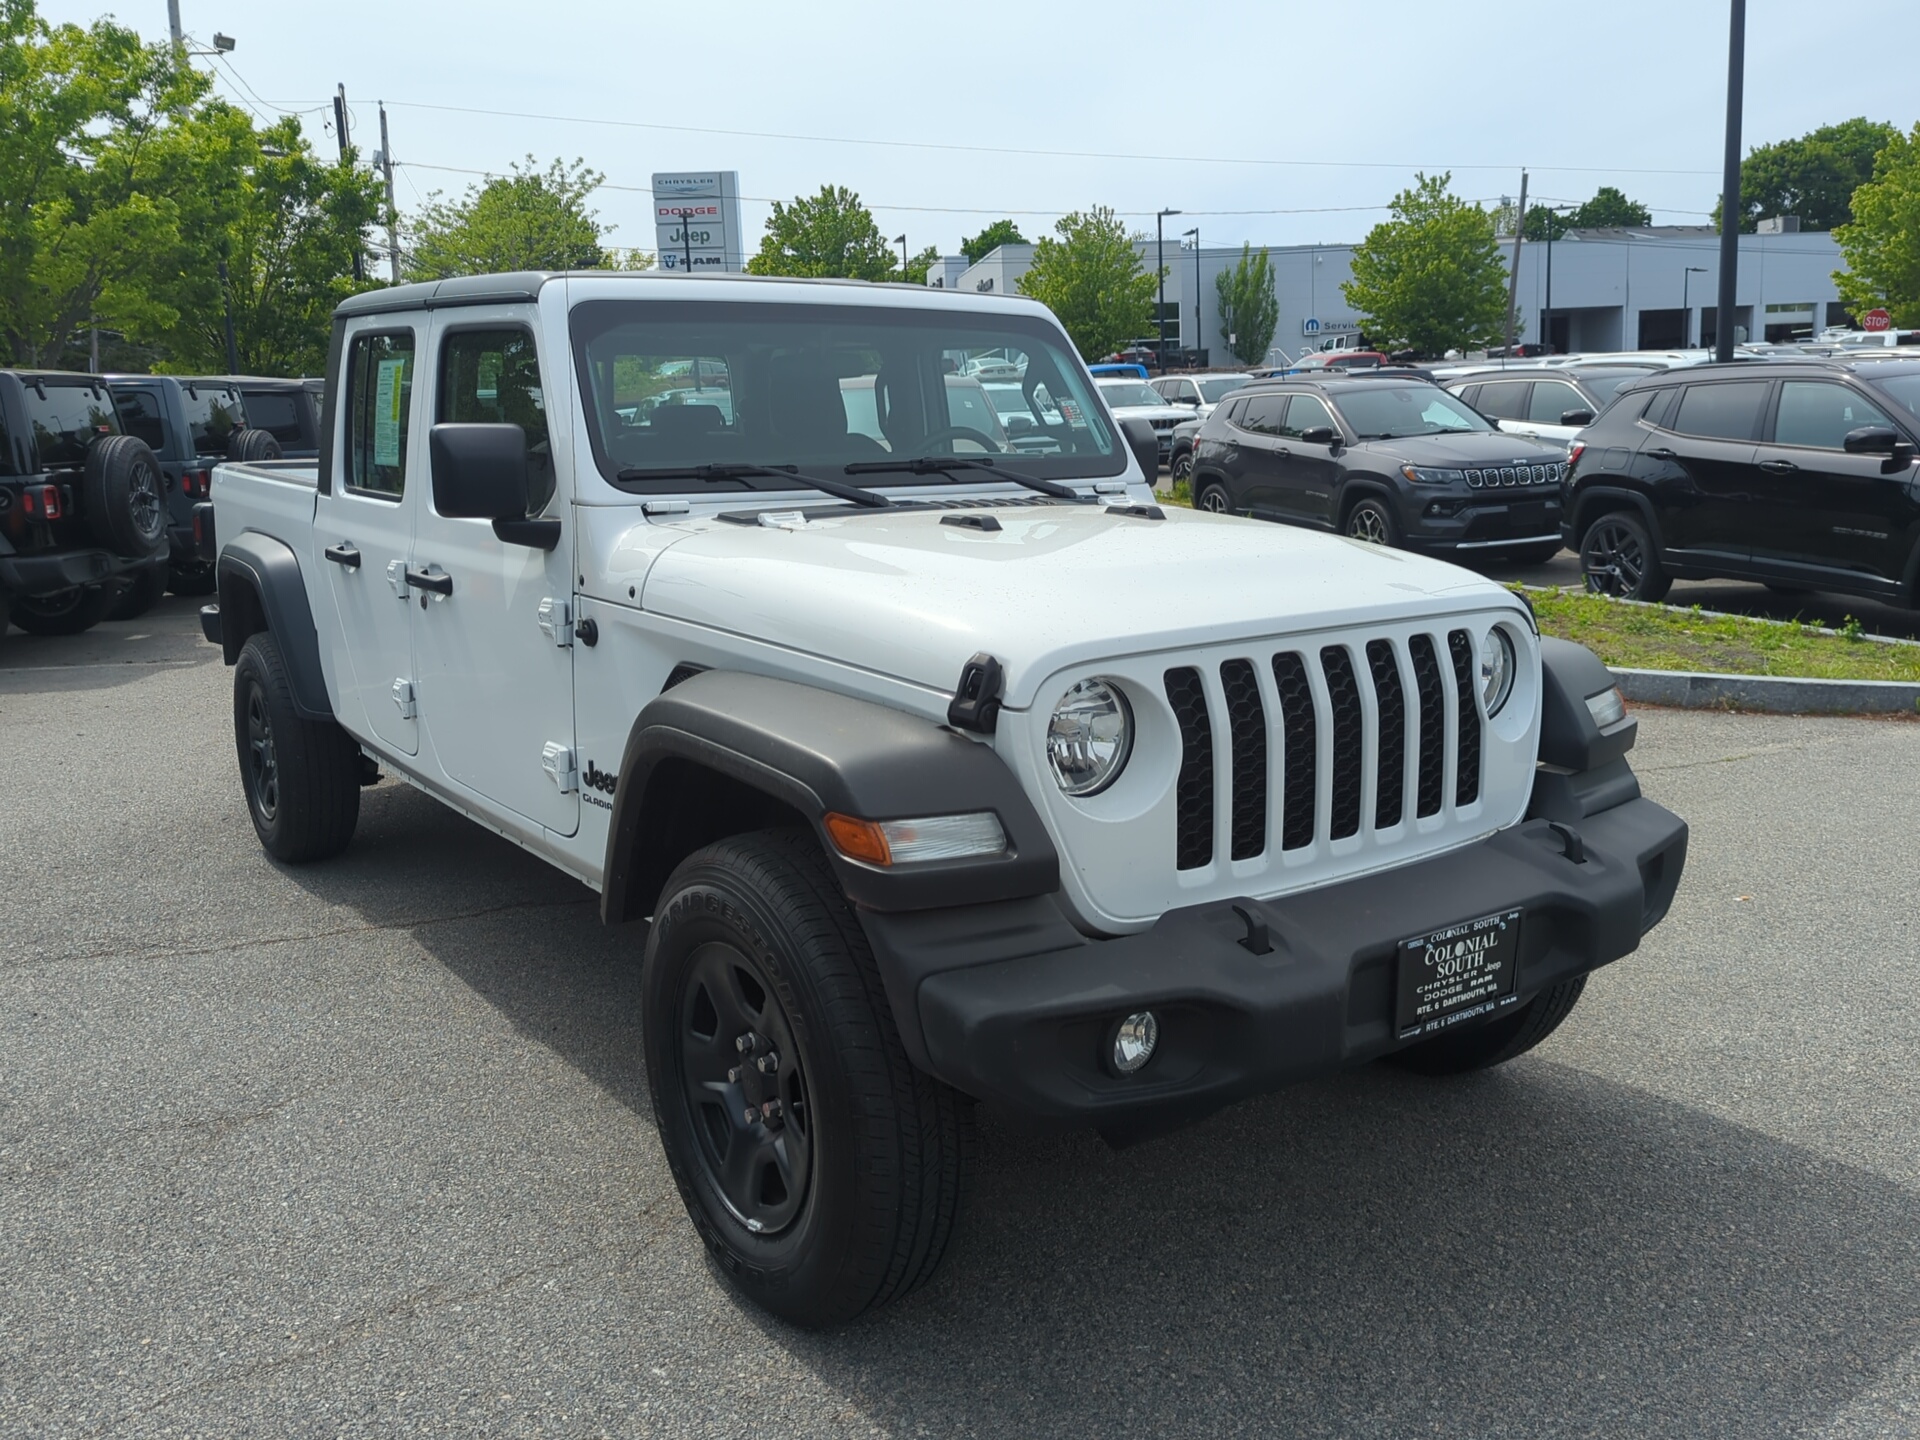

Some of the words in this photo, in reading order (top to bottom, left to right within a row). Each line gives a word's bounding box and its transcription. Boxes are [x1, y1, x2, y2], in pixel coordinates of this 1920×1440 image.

[659, 207, 717, 216] DODGE
[669, 228, 711, 244] Jeep
[680, 257, 721, 265] RAM
[1865, 316, 1889, 327] STOP
[1431, 925, 1469, 943] COLONIAL
[1473, 916, 1500, 931] SOUTH
[1507, 912, 1519, 920] Jeep
[1424, 931, 1498, 966] COLONIAL
[1416, 969, 1478, 994] CHRYSLER
[1484, 961, 1502, 972] Jeep
[1436, 950, 1485, 979] SOUTH
[1416, 1004, 1433, 1015] RTE.
[1434, 1002, 1440, 1010] 6
[1442, 986, 1486, 1008] DARTMOUTH,
[1487, 983, 1498, 992] MA
[1424, 983, 1463, 1002] DODGE
[1470, 974, 1493, 987] RAM
[1500, 996, 1517, 1006] RAM
[1425, 1021, 1440, 1032] RTE.
[1441, 1019, 1445, 1027] 6
[1447, 1006, 1485, 1025] DARTMOUTH,
[1485, 1002, 1495, 1012] MA
